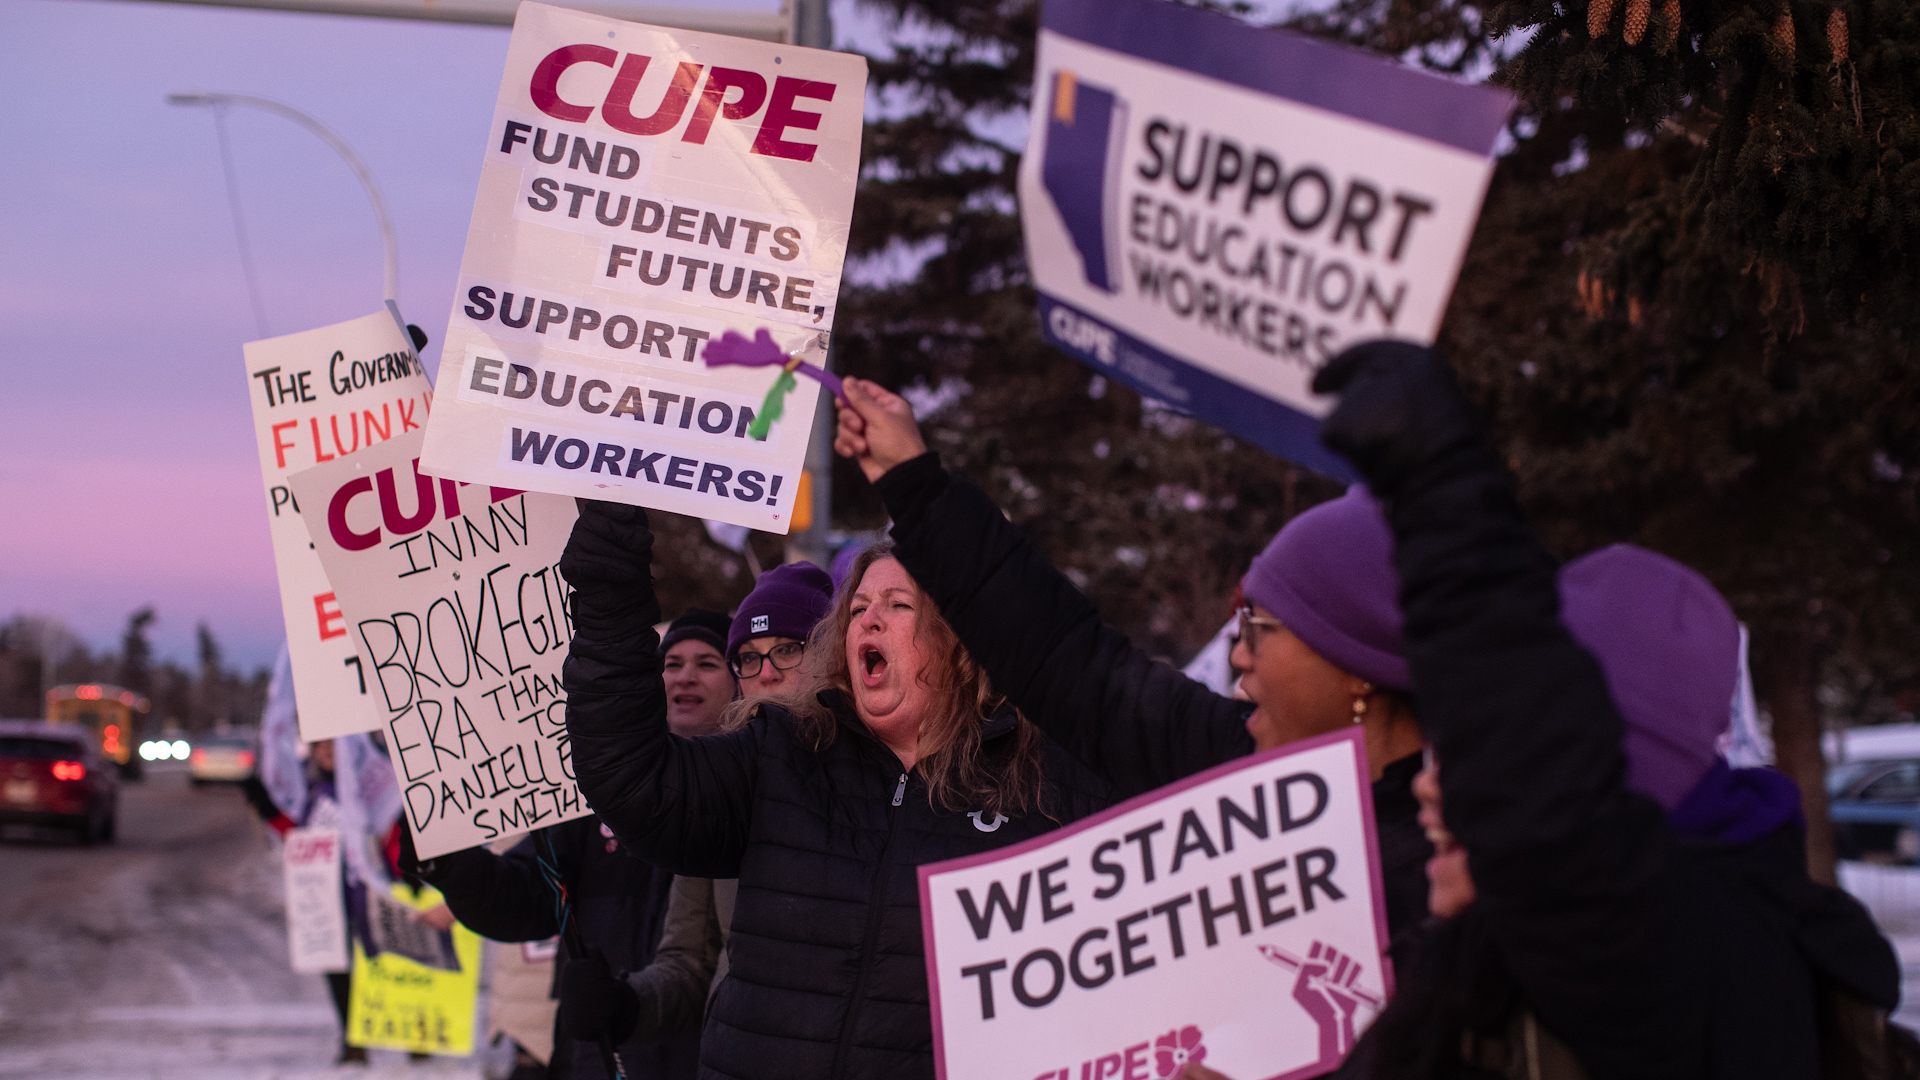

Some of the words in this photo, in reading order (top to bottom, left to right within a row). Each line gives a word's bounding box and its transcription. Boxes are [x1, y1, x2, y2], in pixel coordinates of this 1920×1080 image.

[530, 43, 837, 162] CUPE
[500, 119, 640, 180] FUND
[1136, 118, 1434, 262] SUPPORT
[527, 177, 802, 261] STUDENTS
[1130, 195, 1407, 325] EDUCATION
[463, 285, 710, 363] SUPPORT
[605, 244, 826, 324] FUTURE,
[1129, 250, 1337, 372] WORKERS
[253, 366, 316, 407] THE
[329, 349, 421, 395] GOVERNM
[469, 356, 769, 442] EDUCATION
[511, 427, 783, 506] WORKERS!
[752, 617, 768, 628] HH
[390, 696, 491, 782] ERA
[405, 738, 577, 833] DANIELLE
[955, 858, 1075, 941] WE
[1091, 771, 1329, 900] STAND
[961, 847, 1346, 1021] TOGETHER
